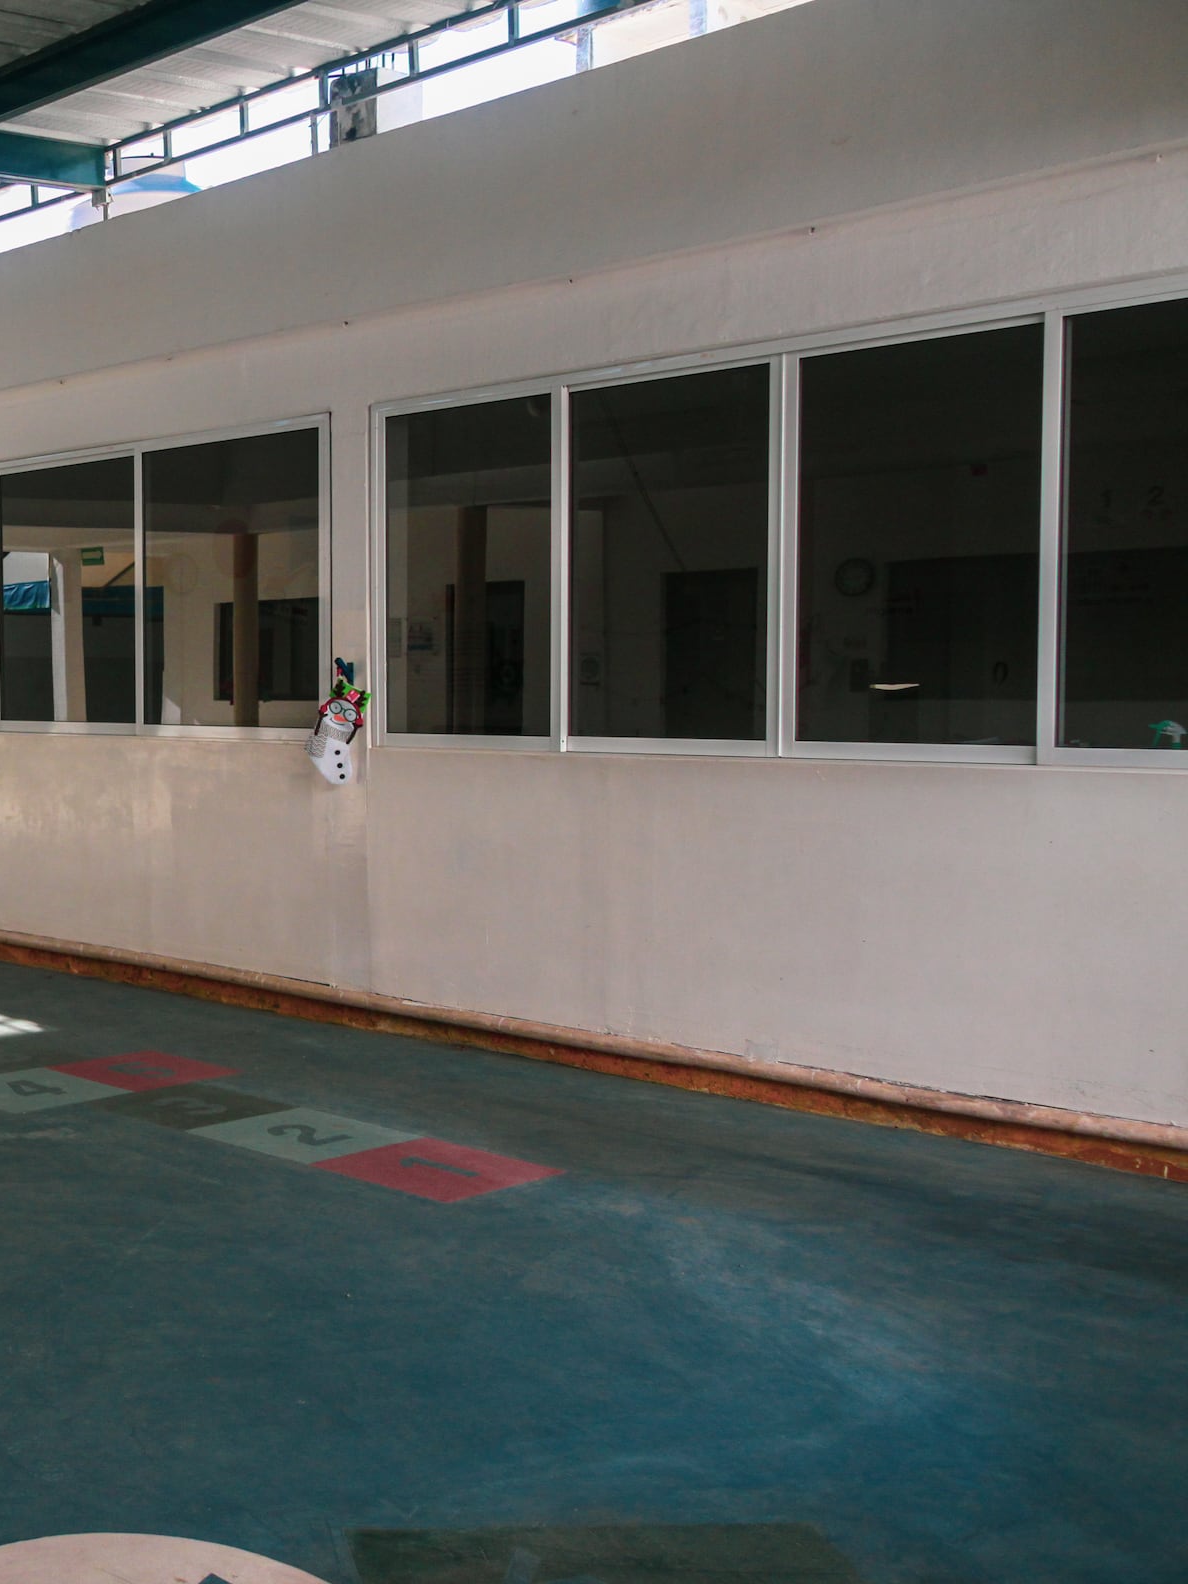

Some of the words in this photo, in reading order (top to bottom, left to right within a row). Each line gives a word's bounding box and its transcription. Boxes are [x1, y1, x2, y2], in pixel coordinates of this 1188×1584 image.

[13, 1079, 67, 1099] 4
[267, 1124, 352, 1147] 2
[399, 1156, 480, 1178] 1
